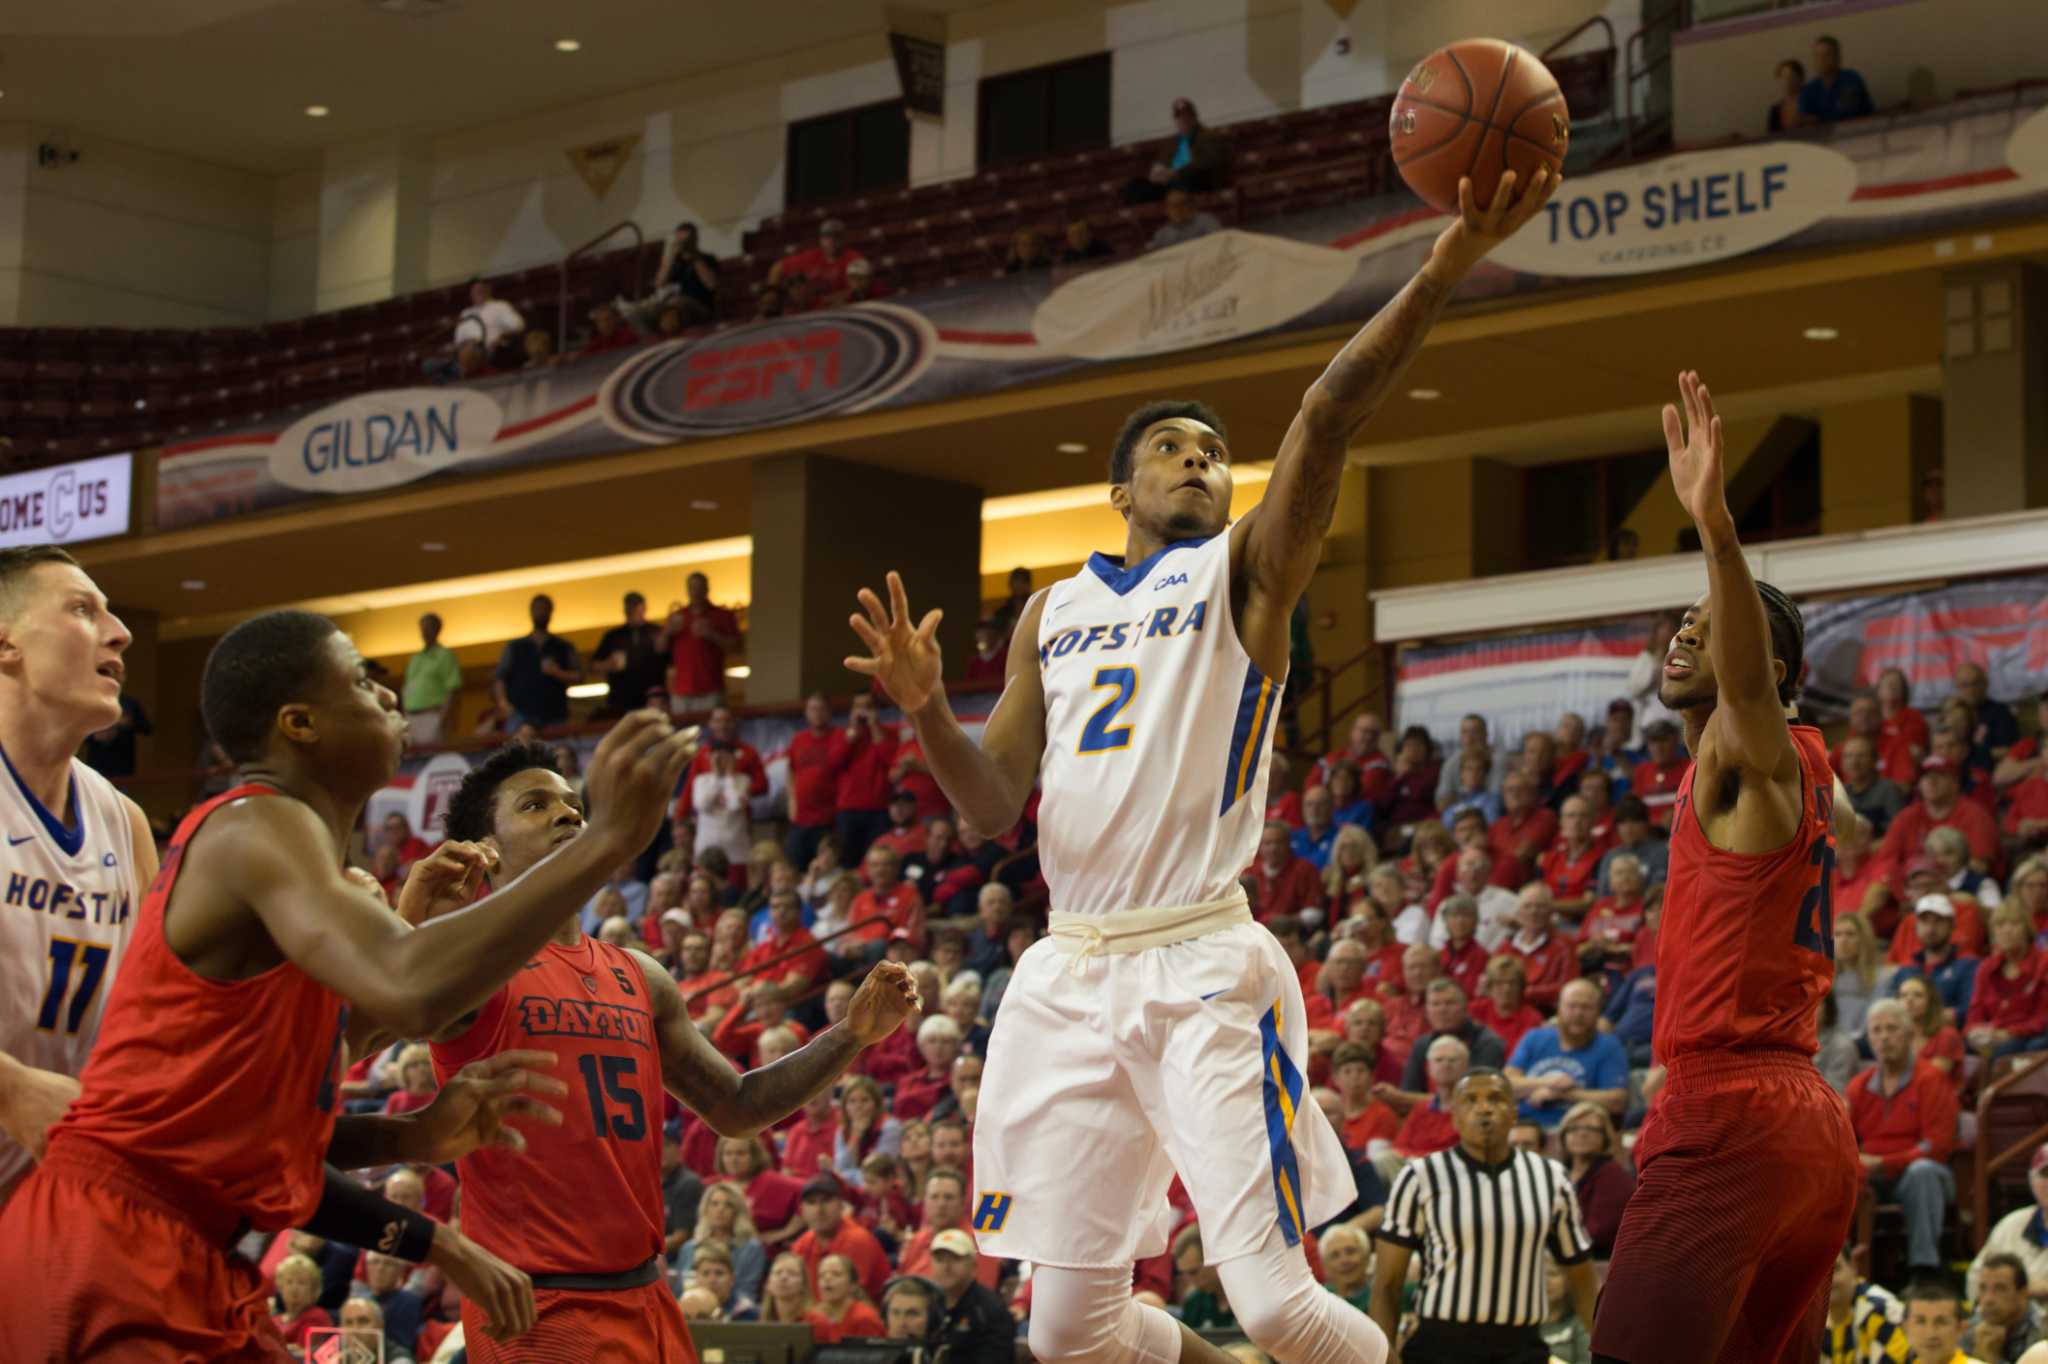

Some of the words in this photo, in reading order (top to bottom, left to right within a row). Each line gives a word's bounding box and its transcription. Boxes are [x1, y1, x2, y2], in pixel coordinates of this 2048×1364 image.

[1545, 190, 1630, 244] TOP
[1642, 163, 1788, 231] SHELF
[681, 328, 842, 413] ESPN
[303, 402, 459, 475] GILDAN
[78, 479, 109, 519] US
[1153, 572, 1189, 592] CAA
[1075, 663, 1139, 757] 2
[37, 932, 114, 1036] 11
[578, 1053, 647, 1142] 15
[972, 1190, 1013, 1233] H
